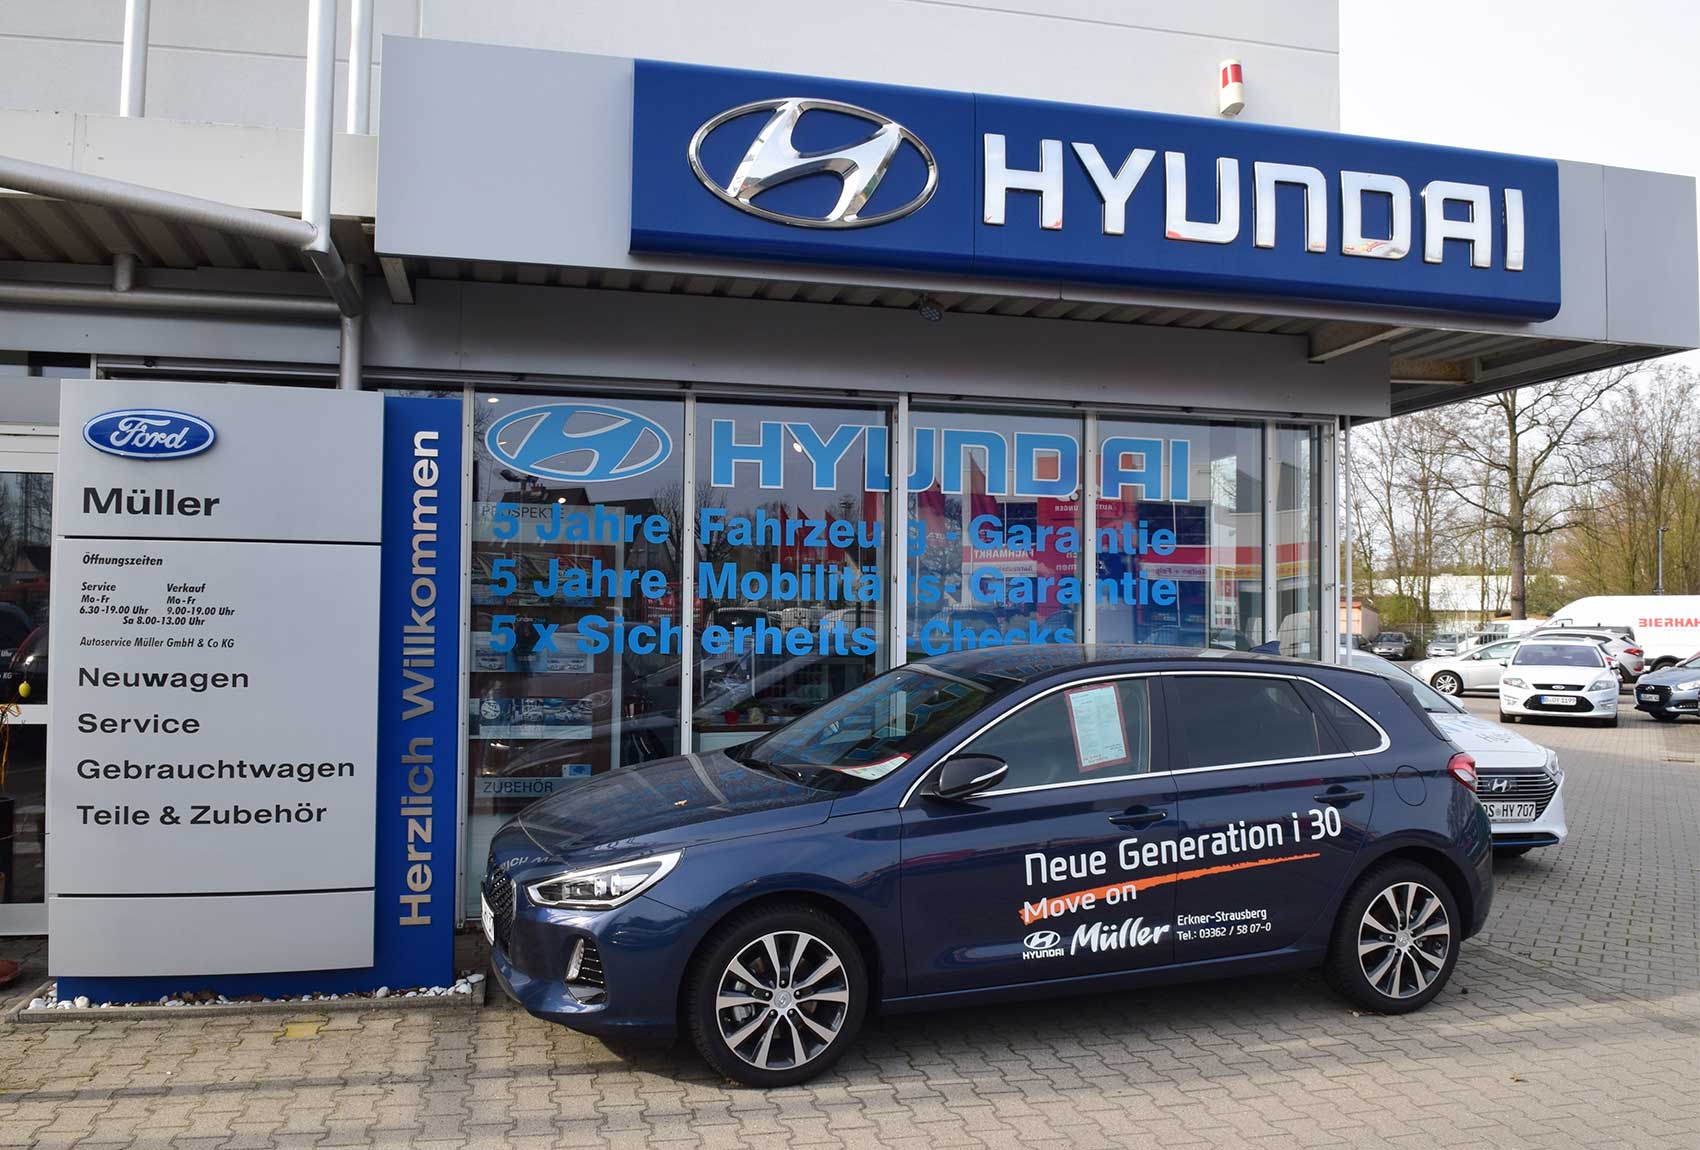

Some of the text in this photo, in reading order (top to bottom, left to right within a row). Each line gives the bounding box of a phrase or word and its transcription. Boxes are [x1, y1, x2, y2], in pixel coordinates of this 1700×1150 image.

[982, 131, 1525, 272] HYUNDAI
[110, 417, 190, 449] Ford
[711, 418, 1191, 503] HYUNDAI
[83, 487, 220, 516] Müller
[492, 502, 519, 541] 5
[535, 502, 669, 544] Jahre
[700, 507, 927, 557] Fahrzeug
[969, 513, 1177, 557] Garantie
[82, 552, 164, 567] Öffnungszeiten
[81, 582, 117, 592] Service
[166, 583, 207, 593] Verkauf
[490, 558, 517, 598] 5
[533, 558, 668, 599] Jahre
[970, 566, 1178, 607] Garantie
[122, 616, 206, 626] Sa 8.00-13.00 Uhr
[132, 606, 149, 615] Uhr
[167, 607, 235, 616] 9.00-19.00 Uhr
[79, 636, 235, 648] Autoservice Müller GmbH & Co KG
[489, 614, 517, 653] 5
[532, 622, 560, 654] x
[78, 667, 250, 693] Neuwagen
[398, 430, 440, 927] Herzlich Willkommen
[77, 713, 201, 734] Service
[76, 759, 356, 783] Gebrauchtwagen
[483, 779, 553, 794] ZUBEHÖR
[76, 802, 328, 825] Teile & Zubehör
[1501, 803, 1516, 817] HY
[1517, 803, 1535, 817] 707
[1023, 806, 1343, 887] Neue Generation i 30
[1022, 882, 1138, 924] Move on
[1177, 907, 1267, 926] Erkner-Strausberg
[1070, 916, 1171, 957] Müller
[1176, 927, 1198, 941] Tel.:
[1199, 925, 1227, 940] 03362
[1236, 923, 1249, 936] 58
[1250, 920, 1272, 935] 07-0
[1022, 948, 1065, 960] HYUNDAI
